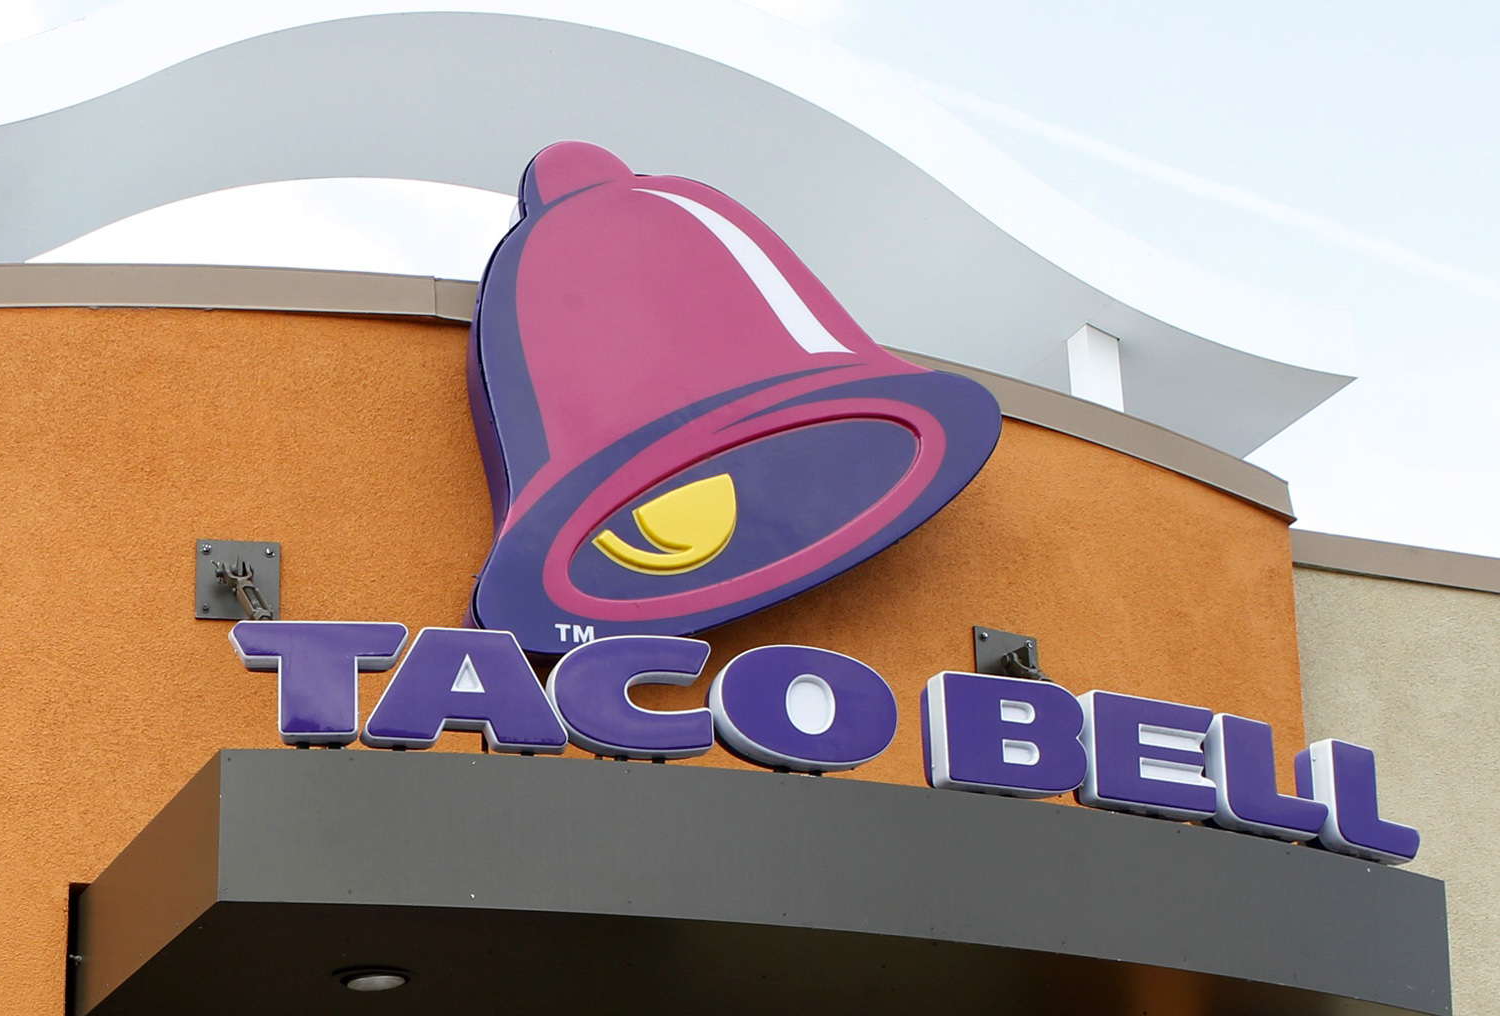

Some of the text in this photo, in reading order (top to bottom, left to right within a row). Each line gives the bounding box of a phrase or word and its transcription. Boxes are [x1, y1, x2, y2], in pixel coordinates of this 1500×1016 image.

[554, 623, 595, 643] TM
[228, 620, 1421, 866] TACO BELL
